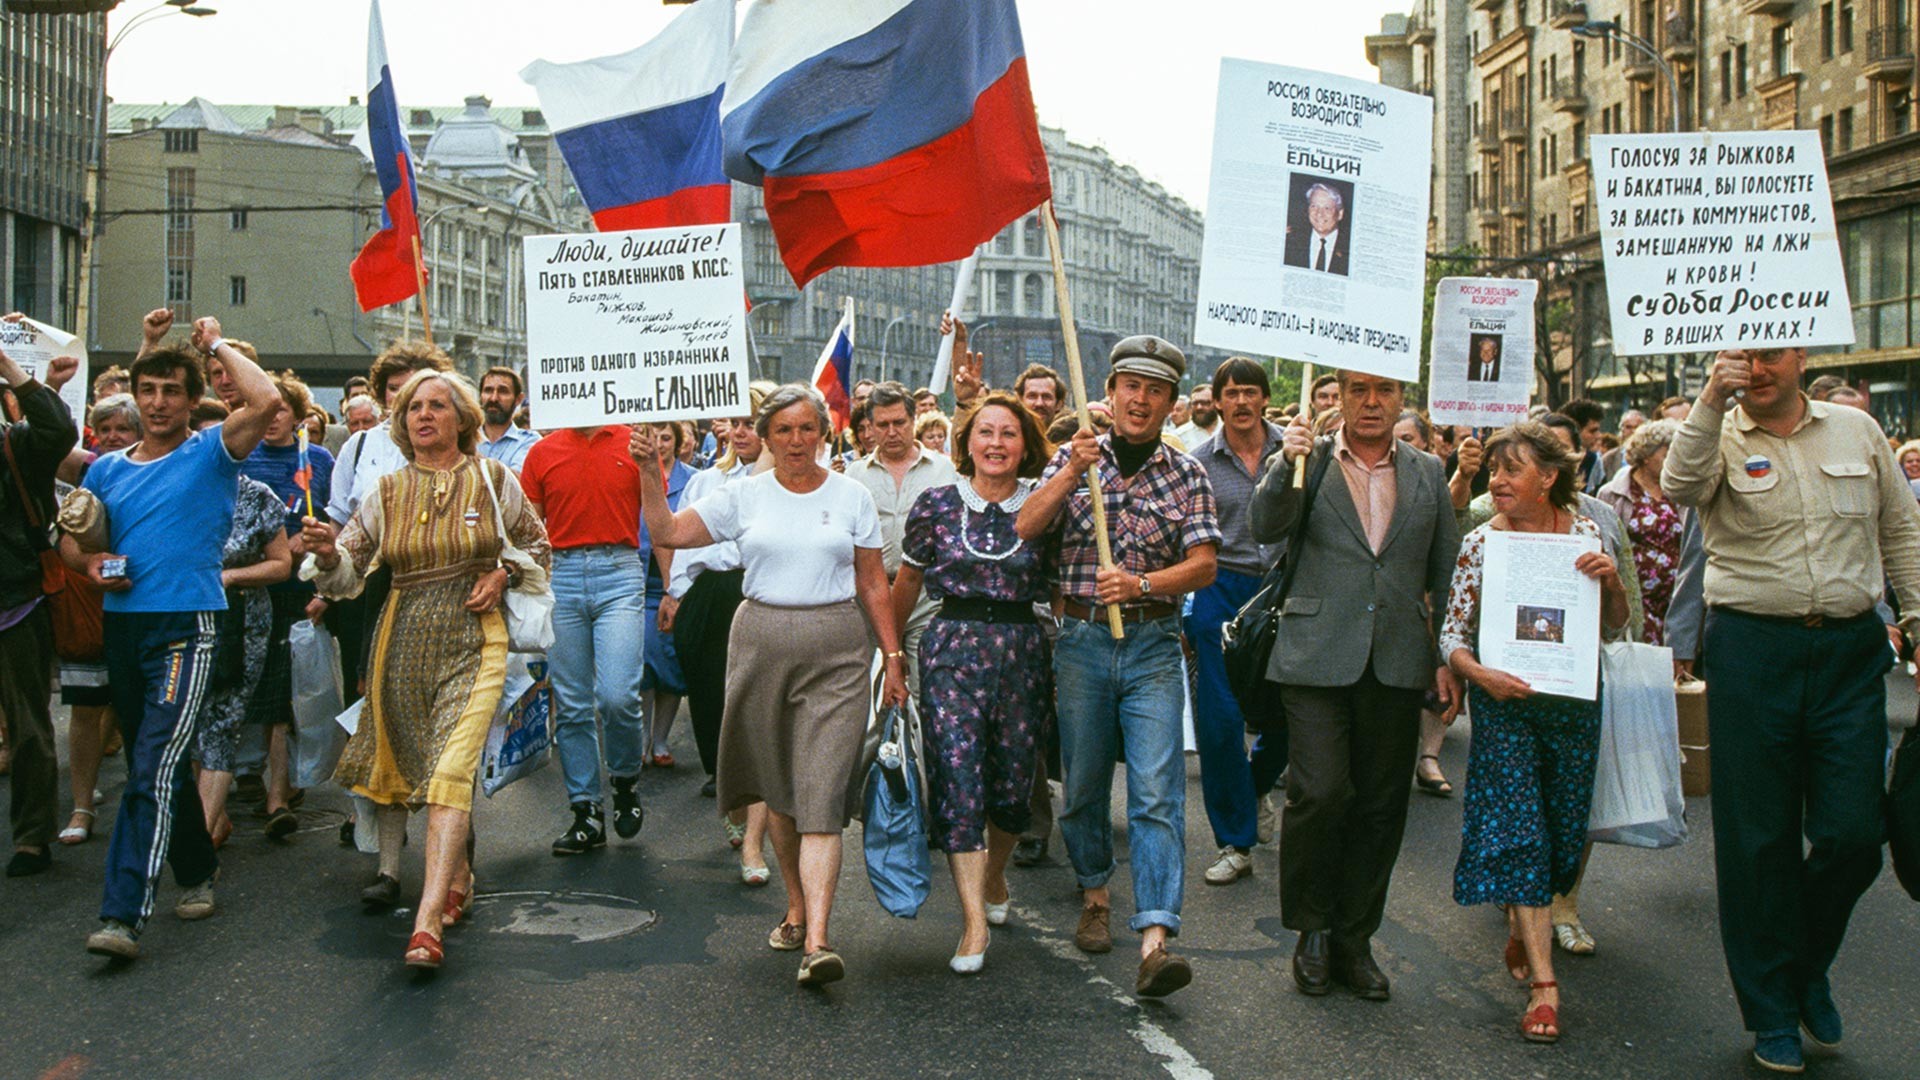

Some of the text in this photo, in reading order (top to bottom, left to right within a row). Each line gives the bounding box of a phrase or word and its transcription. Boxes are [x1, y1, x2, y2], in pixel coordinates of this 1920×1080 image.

[1267, 80, 1386, 117] РОССИЯ ОБЯЗАТЕЛЬНО
[1291, 102, 1363, 128] ВОЗРОДИТСЯ!
[1286, 151, 1361, 176] ЕЛЬЦИН
[1689, 147, 1707, 165] ЗА
[1717, 144, 1795, 165] РЫЖКОВА
[1607, 179, 1617, 198] И
[1715, 177, 1736, 195] ВЫ
[1741, 174, 1814, 195] ГОЛОСУЕТЕ
[1610, 203, 1817, 228] ЗА ВЛАСТЬ КОММУНИСТОВ,
[547, 227, 727, 265] Люди, думайте!
[1615, 232, 1811, 257] ЗАМЕШАННУЮ НА ЛЖИ
[583, 264, 685, 288] СТАВЛЕННИКОВ
[1666, 267, 1677, 285] И
[596, 301, 647, 314] Рыжков,
[639, 314, 733, 335] Жириновский,
[1207, 301, 1257, 326] НАРОДНОГО
[1317, 319, 1361, 345] НАРОДНЫЕ
[1363, 328, 1411, 353] ПРЕЗИДЕНТЫ
[1469, 321, 1506, 331] ЕЛЬЦИН
[1643, 328, 1654, 346] В
[1664, 324, 1725, 346] ВАШИХ
[681, 328, 729, 347] Тулеев
[540, 346, 730, 374] ПРОТИВ ОДНОГО ИЗБРАННИКА
[541, 382, 596, 401] НАРОДА
[656, 372, 740, 412] ЕЛЬЦИНА
